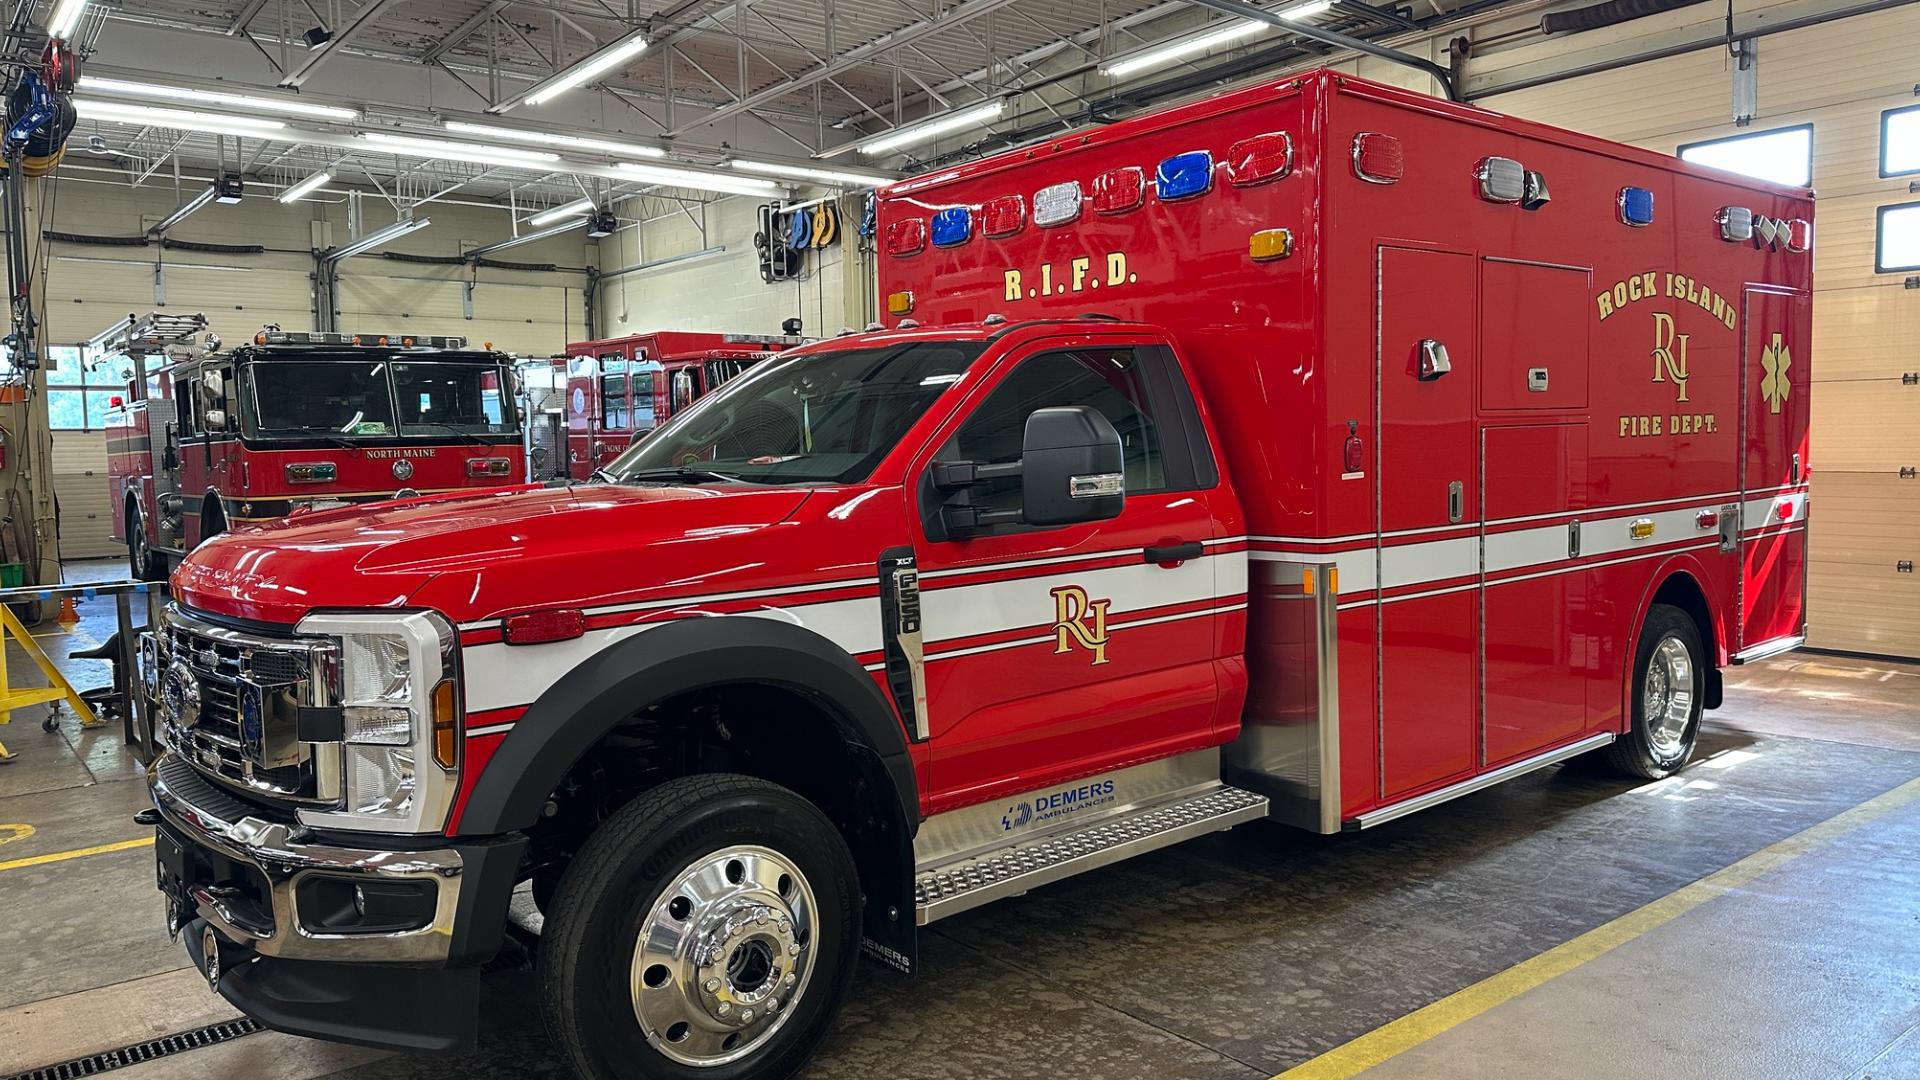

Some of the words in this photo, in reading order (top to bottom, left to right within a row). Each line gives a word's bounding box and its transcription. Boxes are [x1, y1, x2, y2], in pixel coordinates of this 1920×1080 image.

[1003, 251, 1138, 302] R.I.F.D.
[1596, 271, 1657, 321] ROCK
[1665, 273, 1737, 331] ISLAND
[1618, 416, 1662, 437] FIRE
[1670, 414, 1718, 435] DEPT.
[366, 450, 401, 459] NORTH
[403, 449, 436, 458] MAINE
[896, 556, 914, 566] XLT
[1035, 780, 1114, 812] DEMERS
[1035, 795, 1115, 822] AMBULANCES
